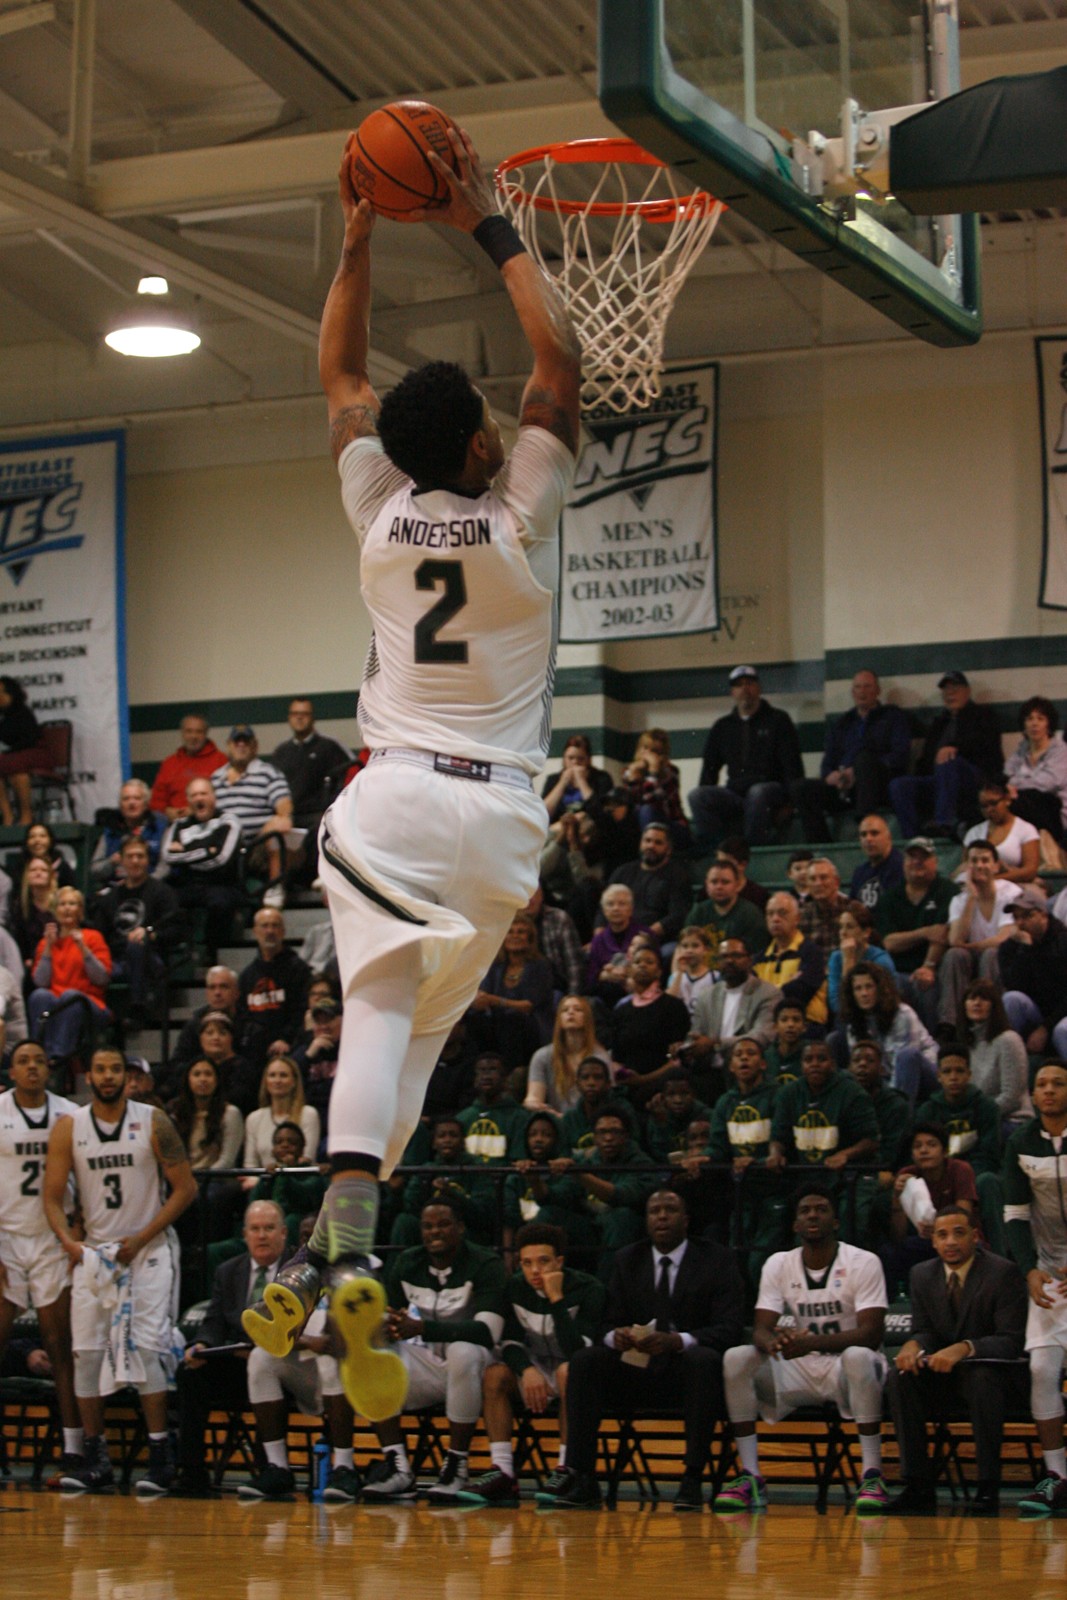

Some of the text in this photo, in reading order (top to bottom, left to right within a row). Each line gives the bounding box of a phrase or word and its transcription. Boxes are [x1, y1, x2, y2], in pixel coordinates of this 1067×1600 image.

[573, 404, 708, 489] NEC
[388, 516, 492, 548] ANDERSON
[601, 518, 674, 543] MEN'S
[567, 541, 710, 573] BASKETBALL
[571, 570, 706, 602] CHAMPIONS
[414, 557, 469, 664] 2
[600, 602, 674, 628] 2002-03
[4, 617, 92, 640] CONNECTICUT
[18, 645, 87, 663] DICKINSON
[87, 1153, 134, 1170] WAGNER
[103, 1173, 123, 1210] 3
